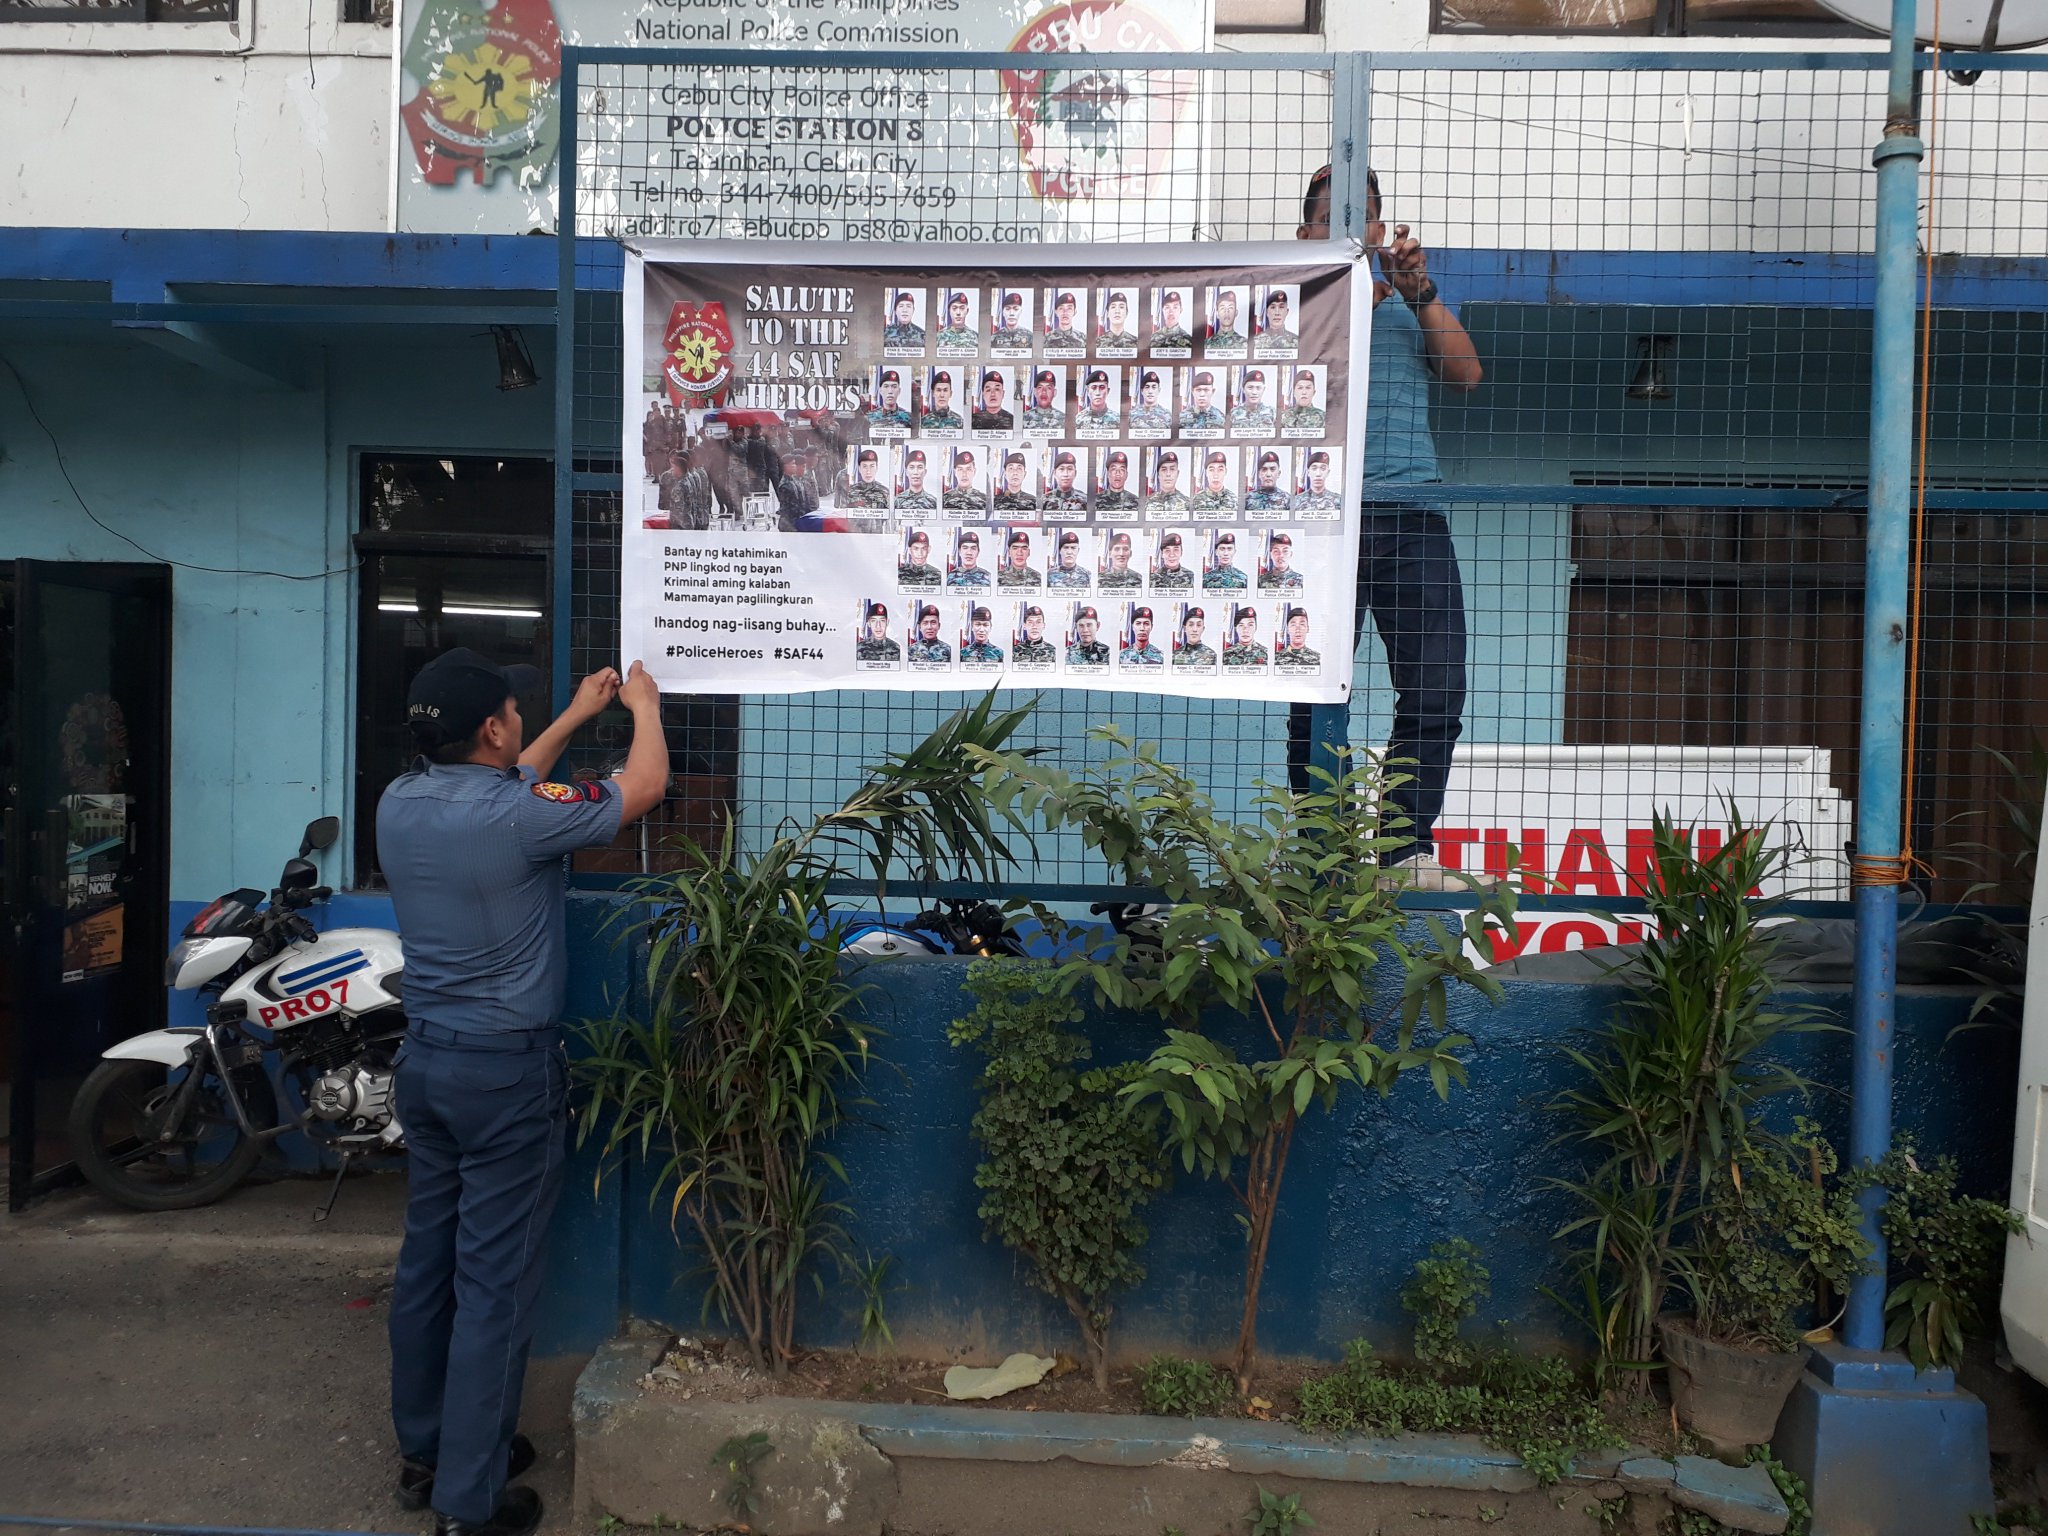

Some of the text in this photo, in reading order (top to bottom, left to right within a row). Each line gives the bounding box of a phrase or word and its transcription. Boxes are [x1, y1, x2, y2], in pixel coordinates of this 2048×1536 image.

[635, 18, 730, 41] National
[817, 20, 959, 43] Commission
[661, 83, 929, 110] Cebu City Police Office
[667, 116, 765, 138] POLICE
[775, 118, 897, 140] STATION
[873, 152, 917, 179] City
[1041, 163, 1146, 194] POLICE
[629, 180, 665, 203] Tel
[745, 285, 855, 313] SALUTE
[745, 318, 849, 345] TO THE
[746, 351, 841, 379] 44 SAF
[746, 383, 861, 412] HEROES
[664, 547, 788, 559] Bantay ng katahimikan
[664, 562, 782, 576] PNP lingkod ng bayan
[664, 577, 791, 590] Kriminal aming kalaban
[664, 592, 814, 606] Mamamayan paglilingkuran
[654, 616, 837, 634] Ihandog nag-iisang buhay...
[666, 645, 824, 660] #PoliceHeroes #SAF44
[410, 703, 440, 718] PULIS
[1484, 921, 1677, 965] YO
[258, 979, 349, 1028] PRO7
